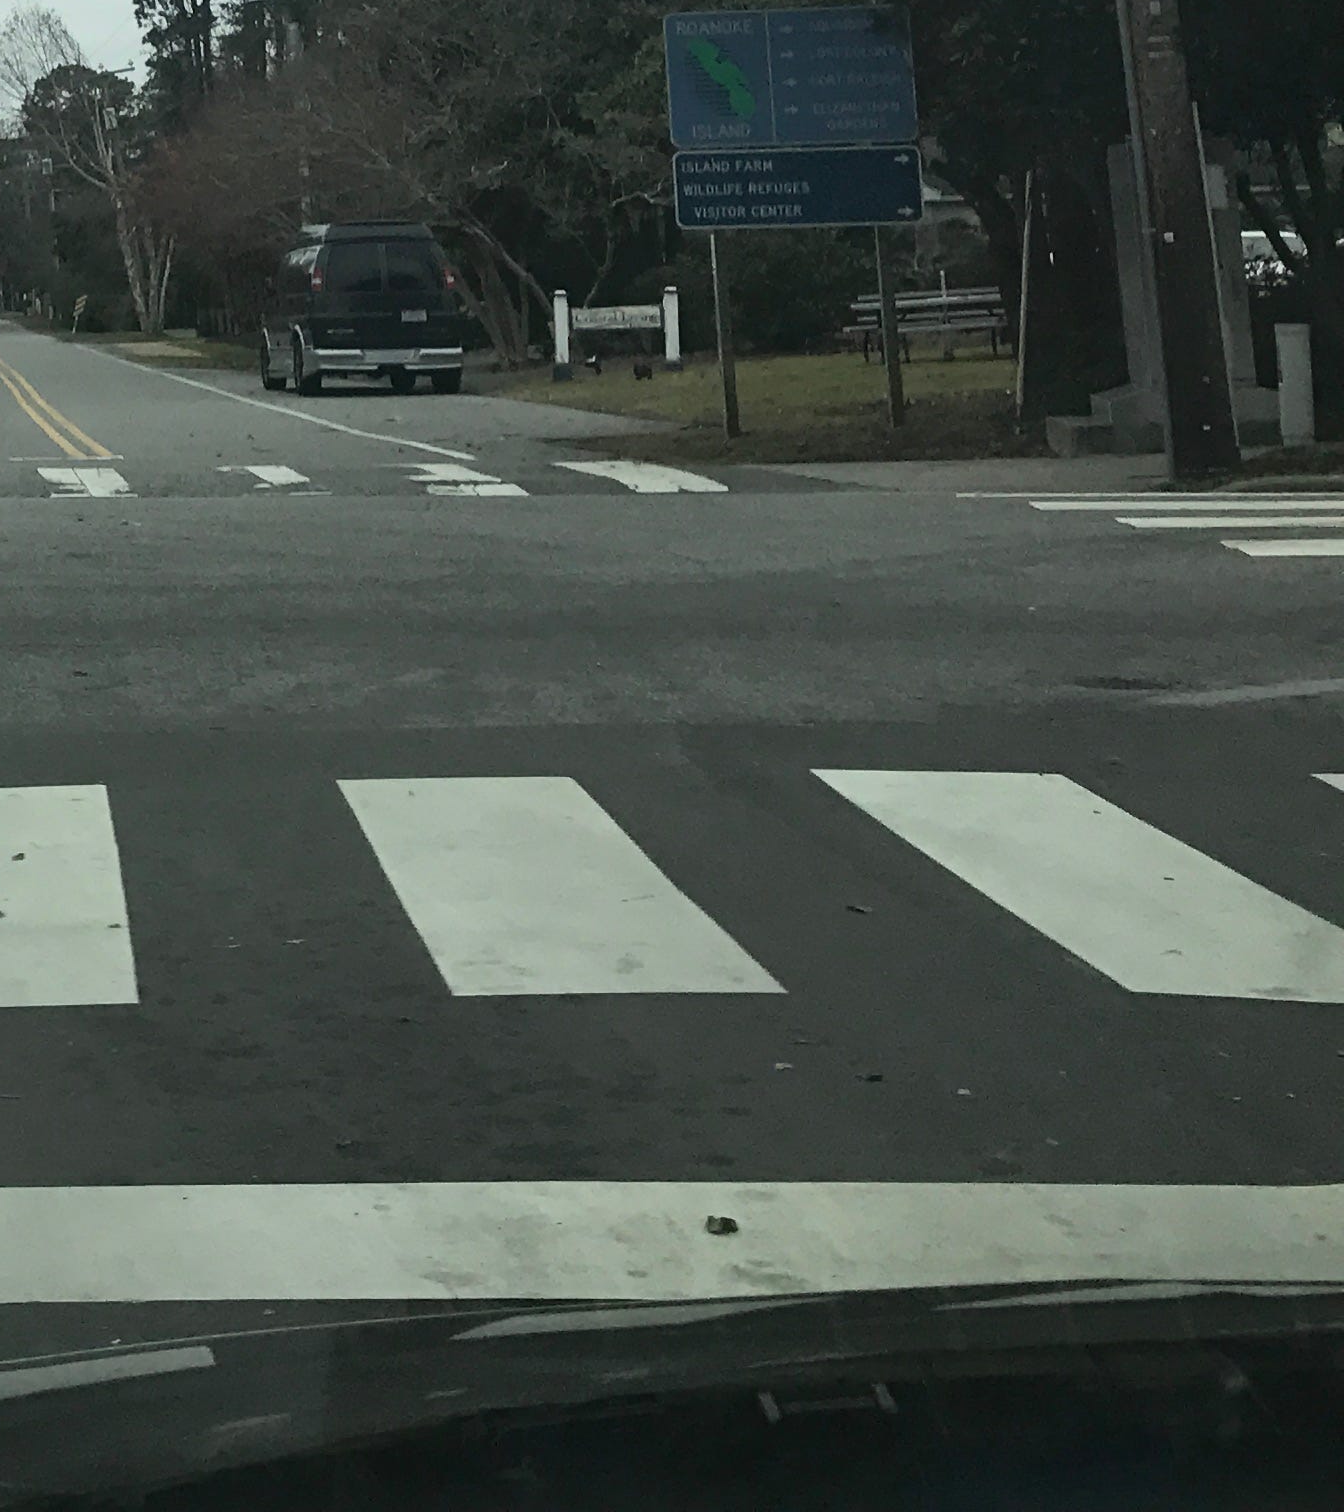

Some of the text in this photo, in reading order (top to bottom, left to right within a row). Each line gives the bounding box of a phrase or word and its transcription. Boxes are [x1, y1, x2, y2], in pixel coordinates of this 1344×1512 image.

[676, 18, 752, 35] ROANOKE
[692, 122, 751, 139] ISLAND
[681, 159, 773, 173] ISLAND FARM
[683, 181, 810, 196] WILDLIFE REFUGES
[694, 204, 803, 219] VISITOR CENTER
